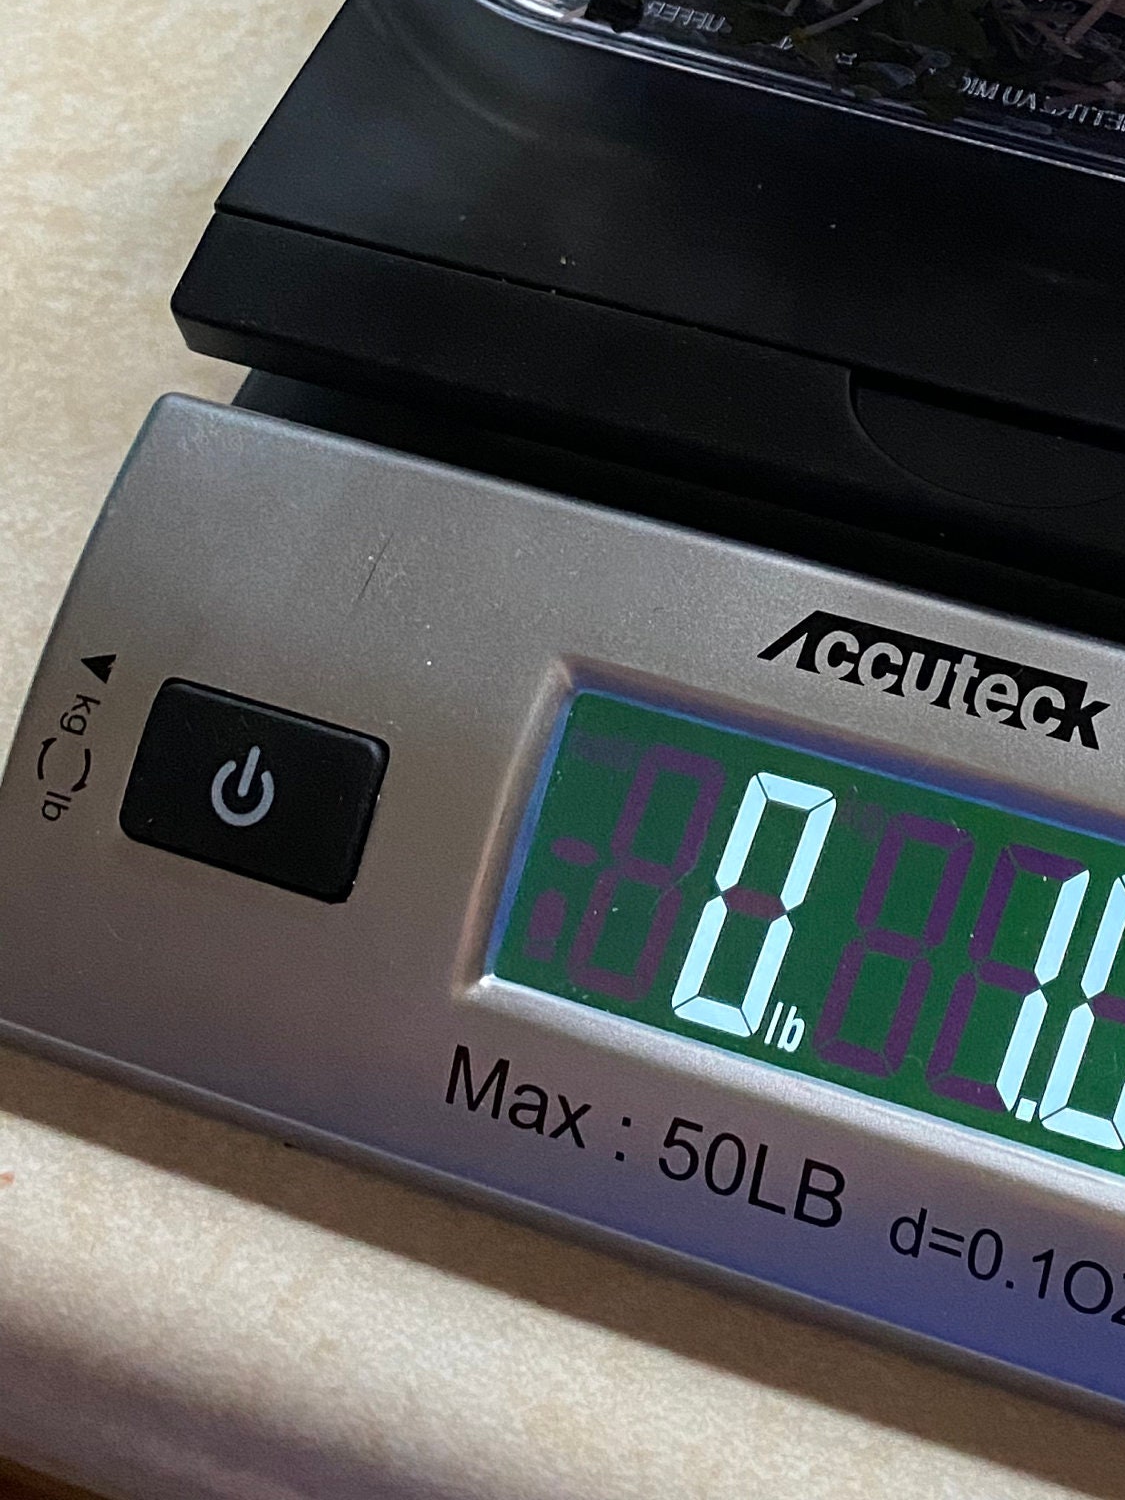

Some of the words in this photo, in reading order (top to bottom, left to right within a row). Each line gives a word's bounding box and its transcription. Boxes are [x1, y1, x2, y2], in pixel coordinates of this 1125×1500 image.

[60, 694, 101, 735] kg
[757, 610, 1111, 750] Accuteck
[41, 791, 72, 822] lb
[672, 772, 837, 1037] 0
[763, 1000, 805, 1052] lb
[444, 1045, 591, 1149] Max
[657, 1122, 847, 1229] 50LB
